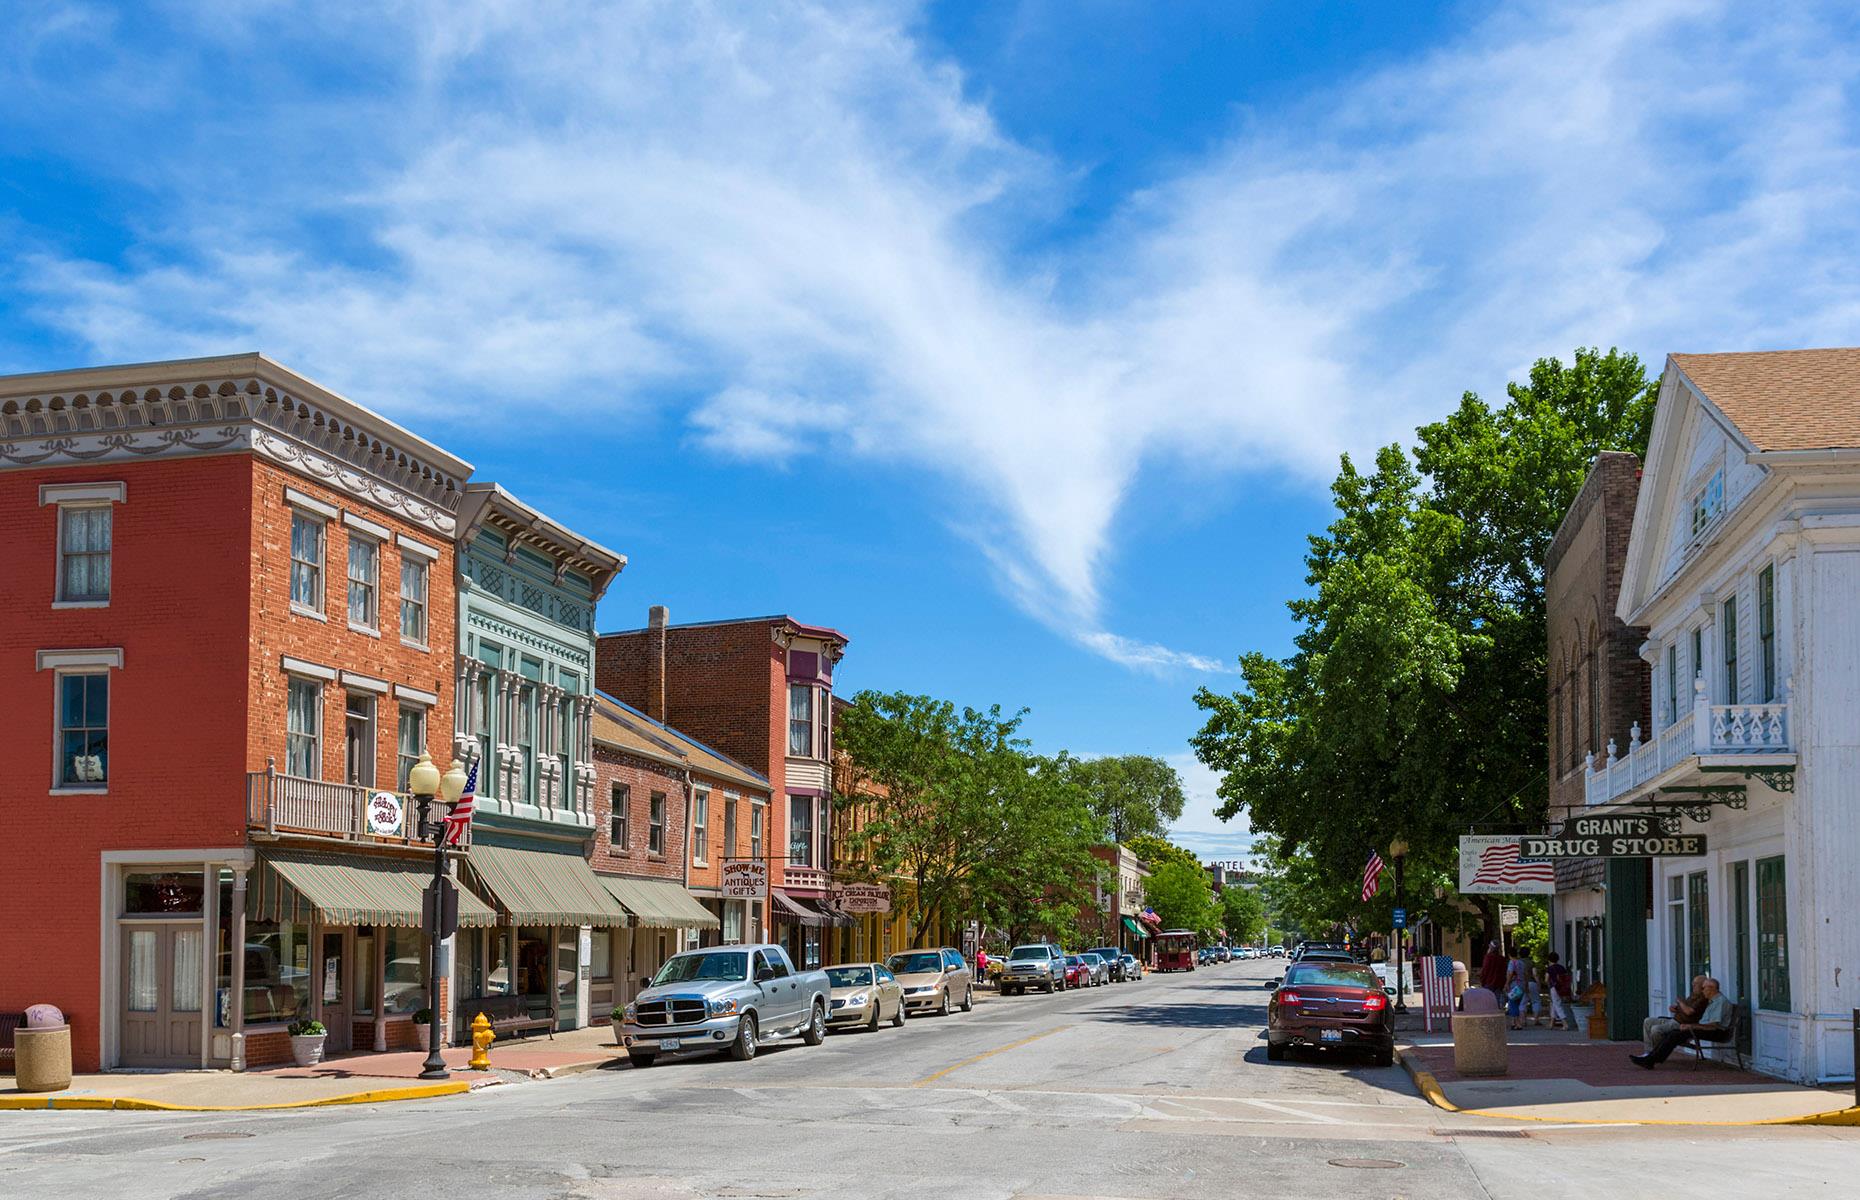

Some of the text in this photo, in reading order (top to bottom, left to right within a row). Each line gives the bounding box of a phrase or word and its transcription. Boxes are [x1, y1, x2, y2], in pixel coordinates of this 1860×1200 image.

[1576, 819, 1649, 835] GRANT'S
[1464, 836, 1520, 845] American Mad
[1528, 838, 1698, 856] DRUG STORE
[724, 863, 765, 876] SHOW-ME
[1211, 861, 1245, 870] HOTEL
[724, 878, 765, 887] ANTIQUES
[733, 887, 756, 896] GIFTS
